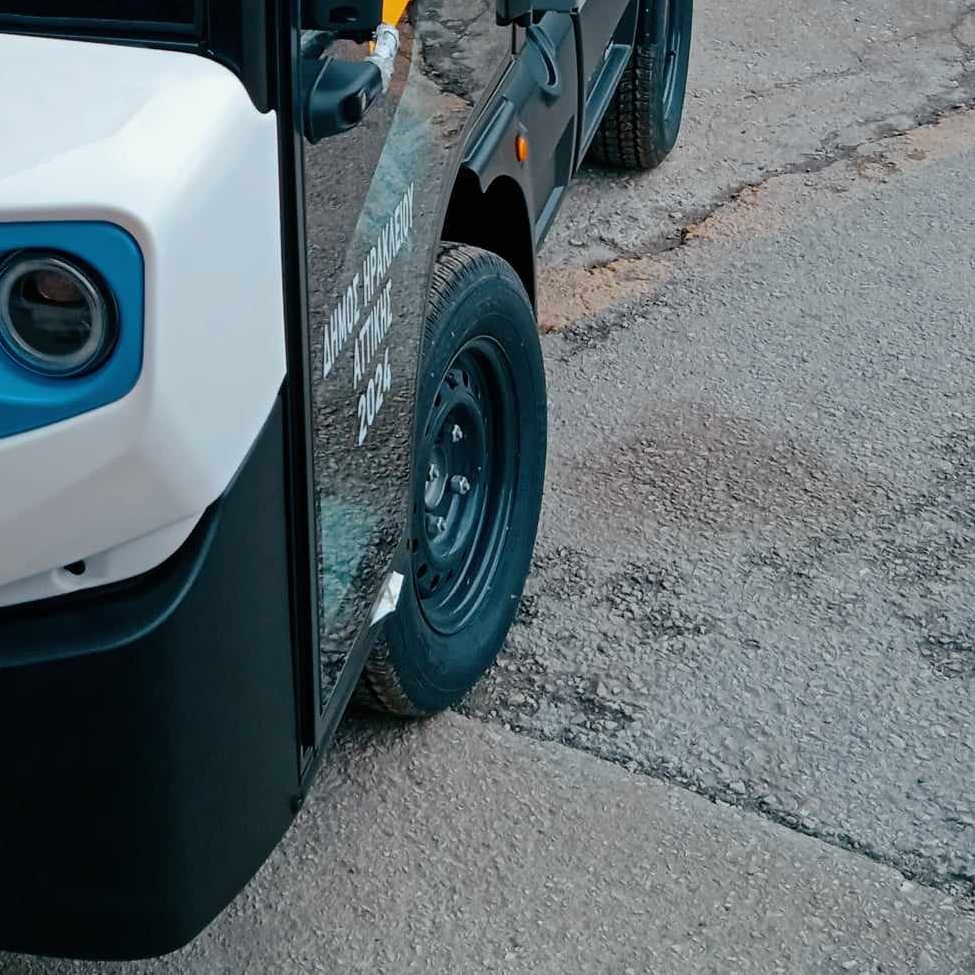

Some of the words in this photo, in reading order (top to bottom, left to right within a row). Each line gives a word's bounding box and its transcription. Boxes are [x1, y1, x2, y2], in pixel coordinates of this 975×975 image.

[323, 273, 361, 377] ΔΗΜΟΣ
[363, 182, 414, 306] ΗΡΑΚΛΕΙΟΥ
[353, 279, 393, 390] ΑΤΤΙΚΗΣ
[358, 347, 392, 446] 2024
